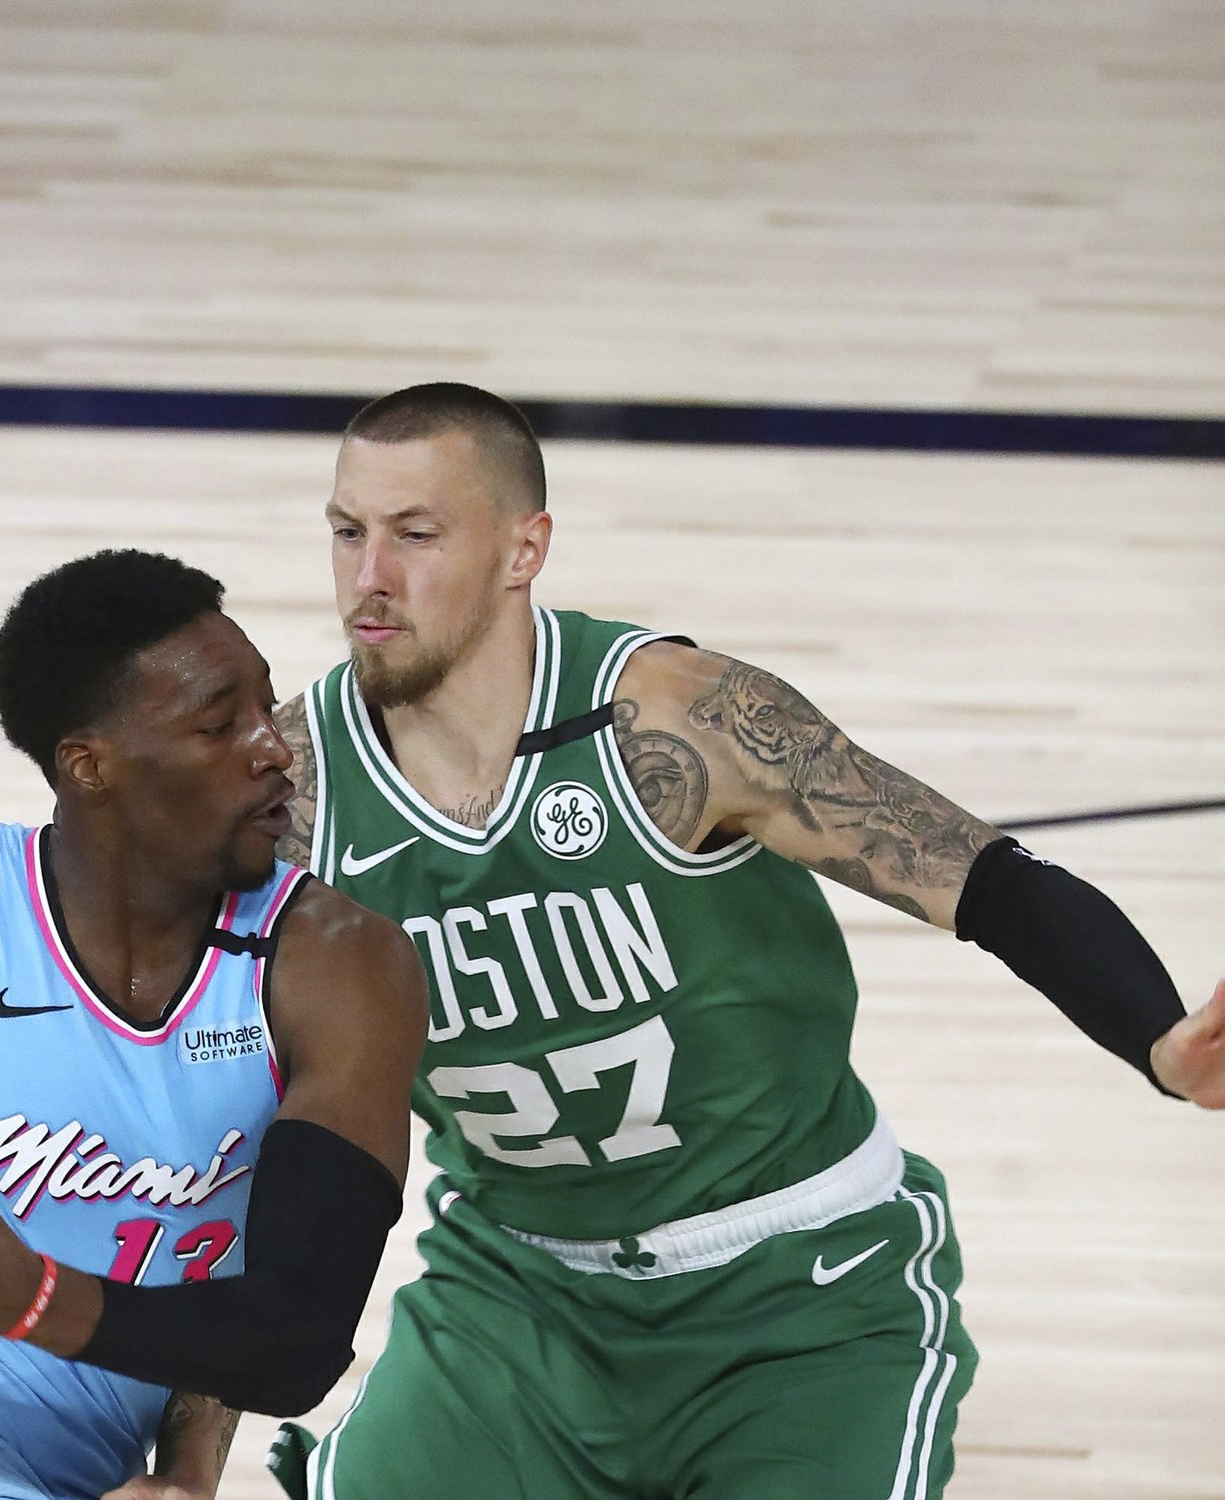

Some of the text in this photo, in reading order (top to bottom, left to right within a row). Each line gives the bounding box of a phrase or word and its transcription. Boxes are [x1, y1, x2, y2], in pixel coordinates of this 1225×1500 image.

[546, 797, 593, 845] GE
[401, 882, 679, 1043] OSTON
[184, 1025, 263, 1050] Ultimate
[190, 1041, 263, 1062] SOFTWARE
[426, 1015, 683, 1168] 27
